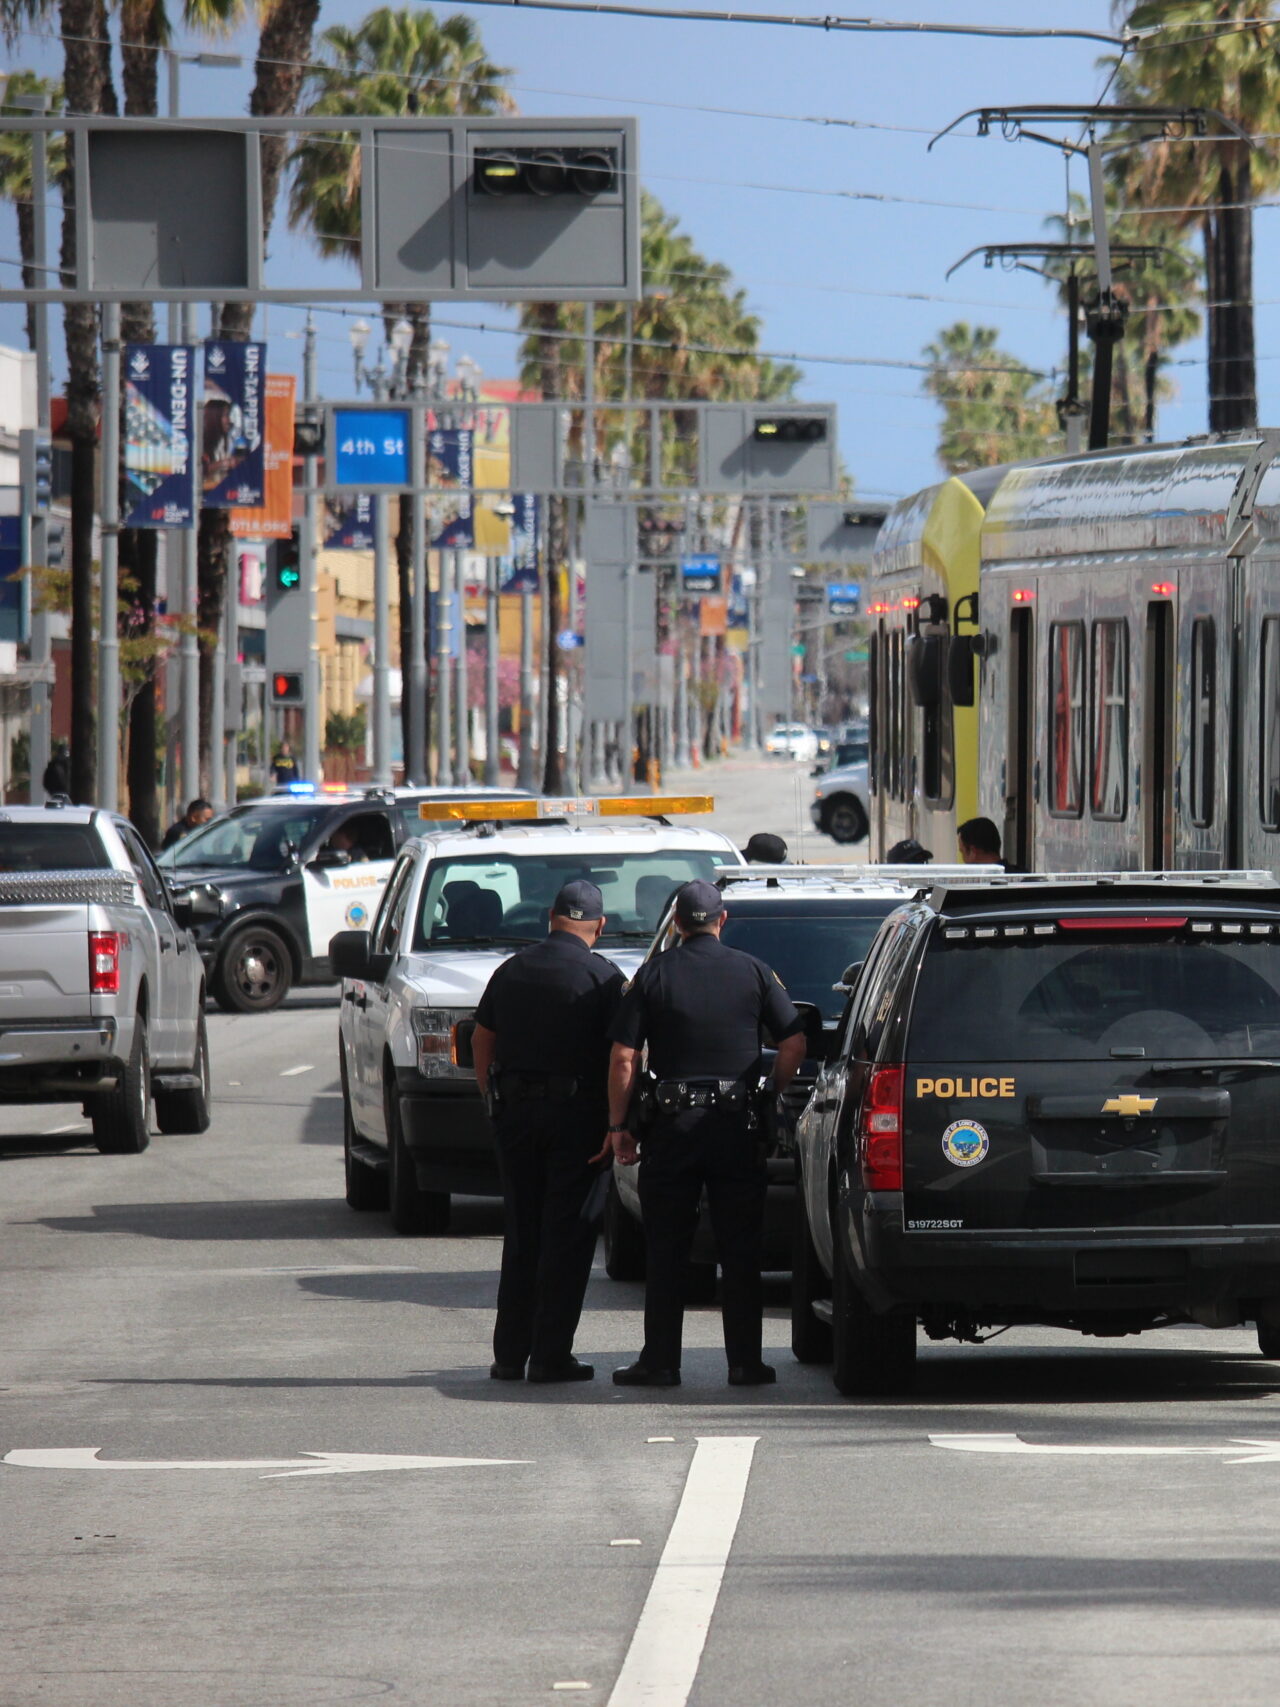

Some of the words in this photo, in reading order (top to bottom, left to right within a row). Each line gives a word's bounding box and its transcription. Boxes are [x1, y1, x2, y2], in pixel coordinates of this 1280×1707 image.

[244, 347, 260, 441] UN-TAPPED
[340, 438, 375, 456] 4th
[383, 438, 404, 456] St
[333, 875, 377, 889] POLICE
[916, 1078, 1016, 1098] POLICE
[908, 1219, 964, 1229] S19722SGT
